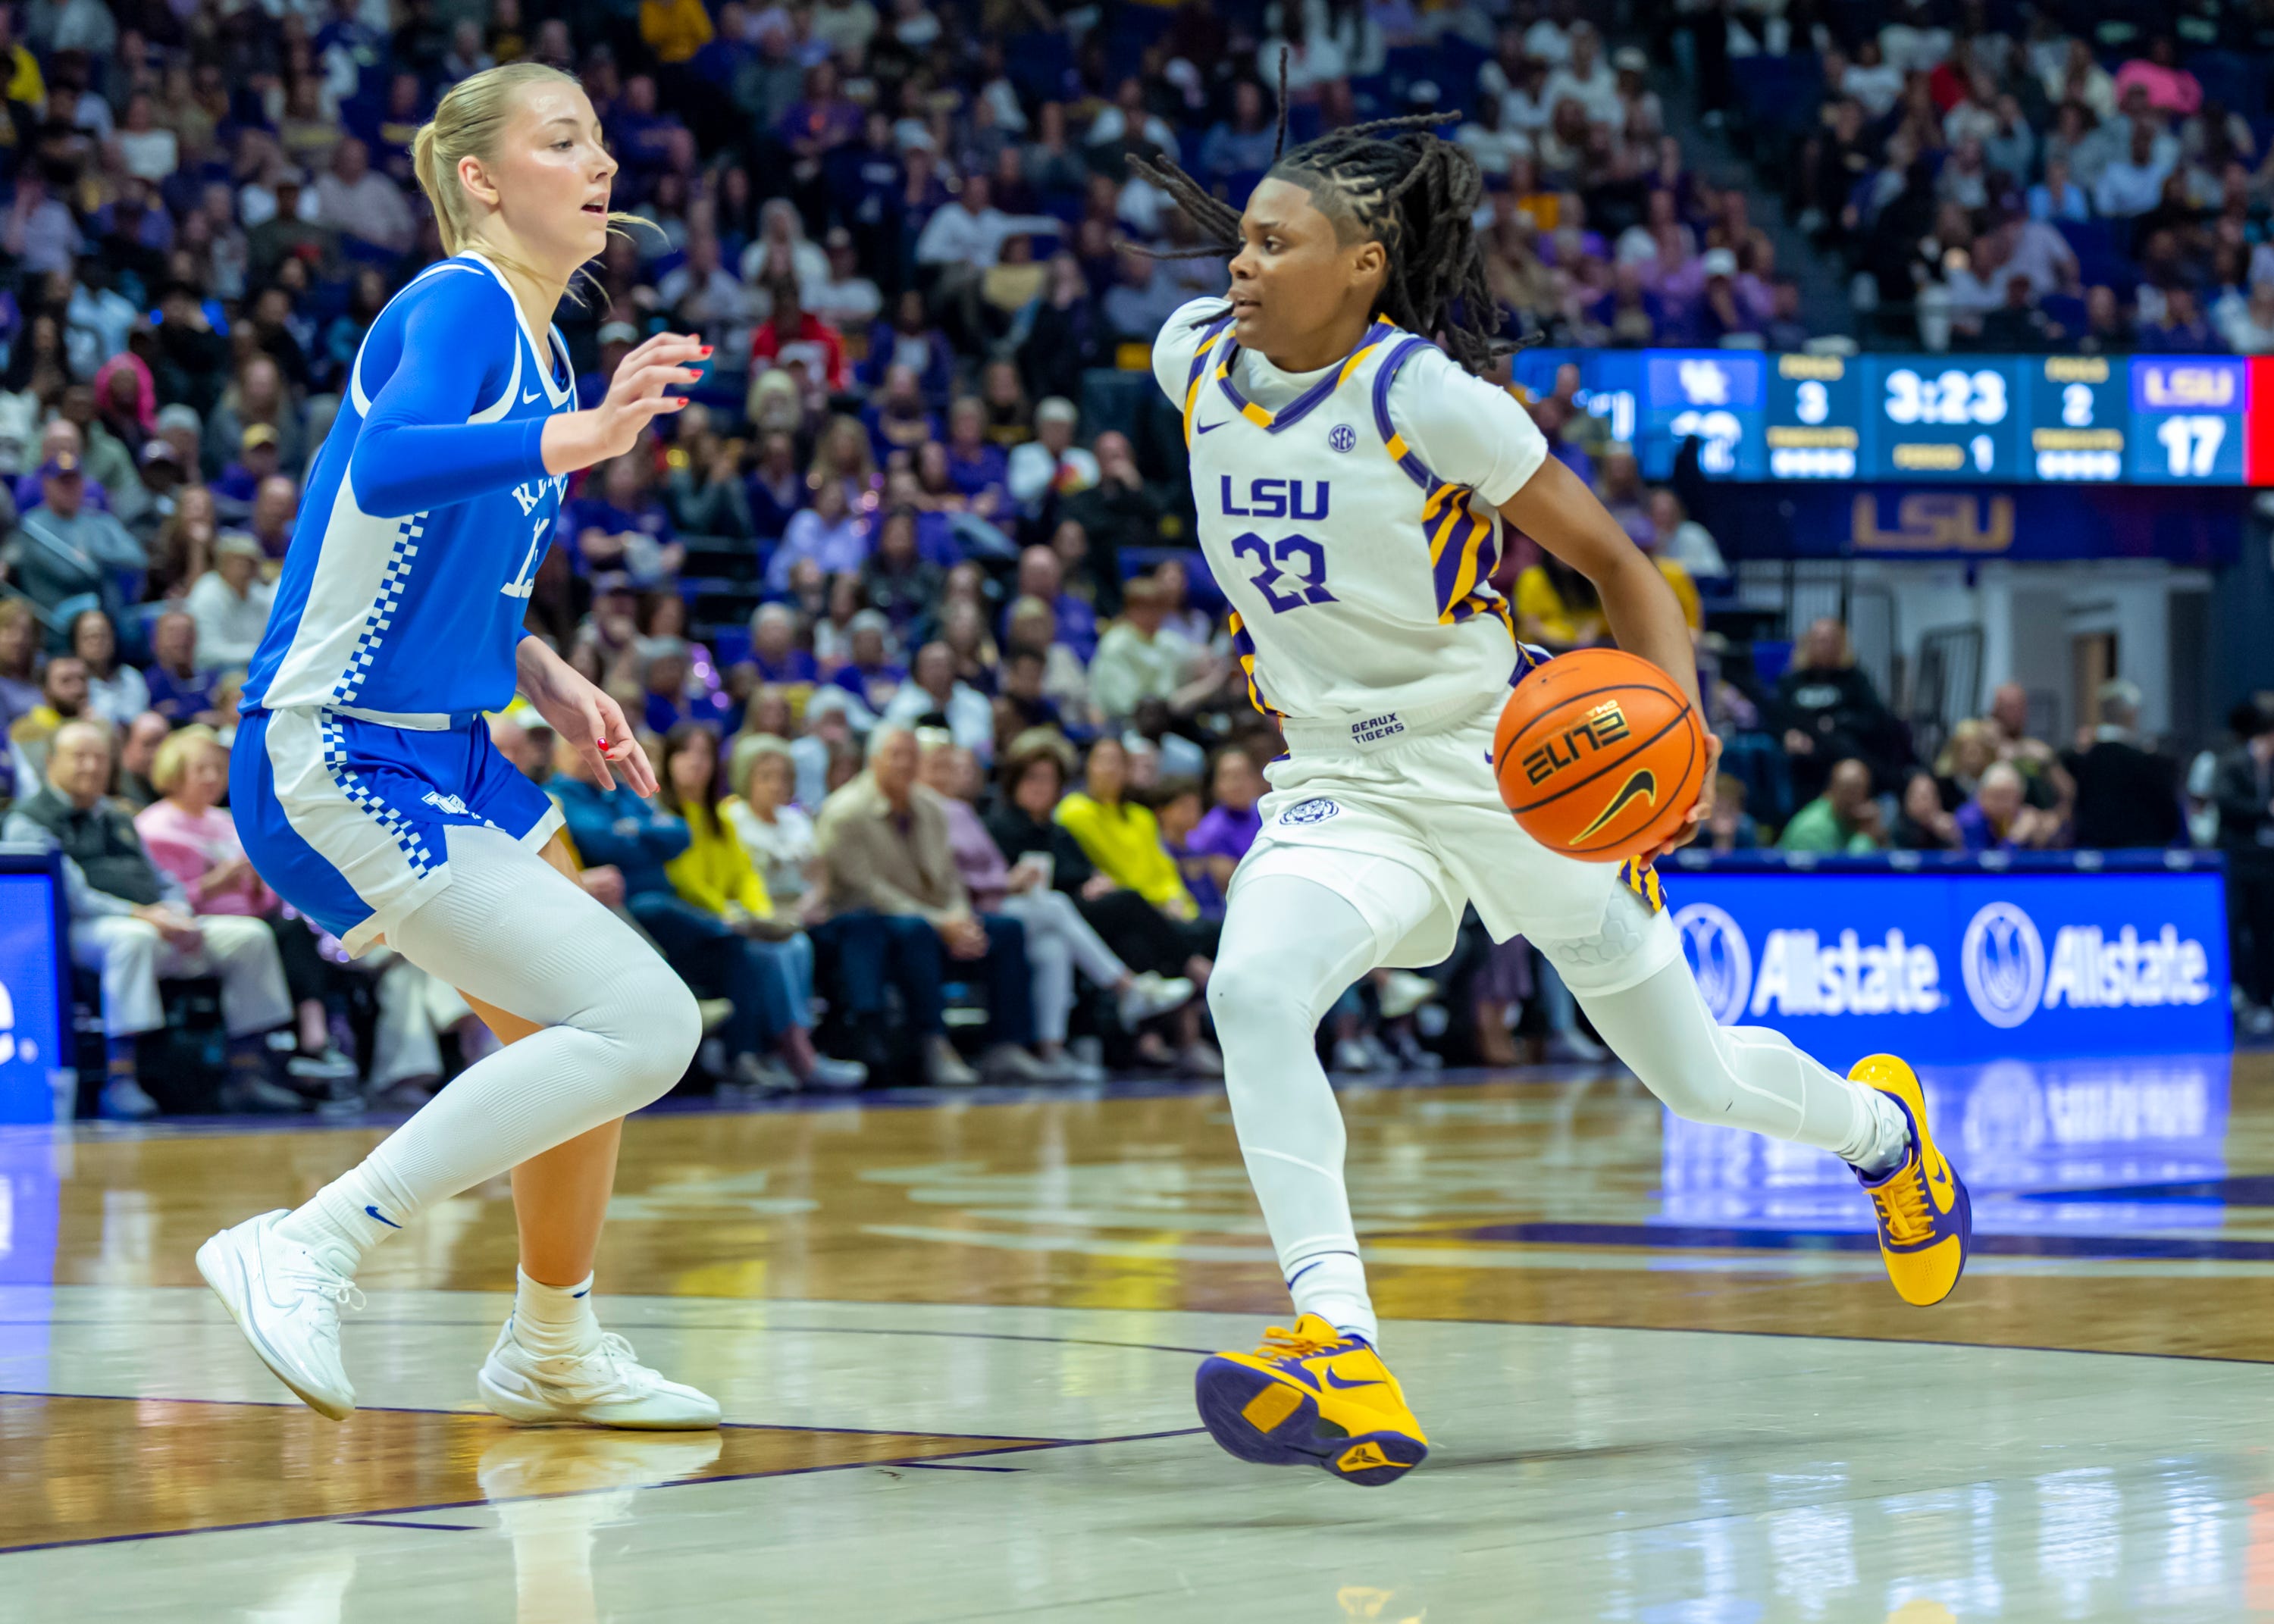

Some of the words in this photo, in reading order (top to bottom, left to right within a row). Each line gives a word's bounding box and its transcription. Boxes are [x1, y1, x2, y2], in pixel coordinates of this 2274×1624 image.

[1796, 380, 1828, 424] 3
[1885, 369, 2008, 424] 3:23
[2063, 383, 2094, 426] 2
[2144, 368, 2234, 406] LSU
[1332, 427, 1353, 449] SEC
[2158, 415, 2225, 477] 17
[1221, 475, 1330, 521] LSU
[1851, 493, 2016, 552] LSU
[1352, 712, 1398, 734] GEAUX
[1352, 722, 1405, 744] TIGERS
[1522, 711, 1630, 787] ELITE
[1750, 928, 1940, 1017] Allstate
[2043, 923, 2209, 1009] Allstate
